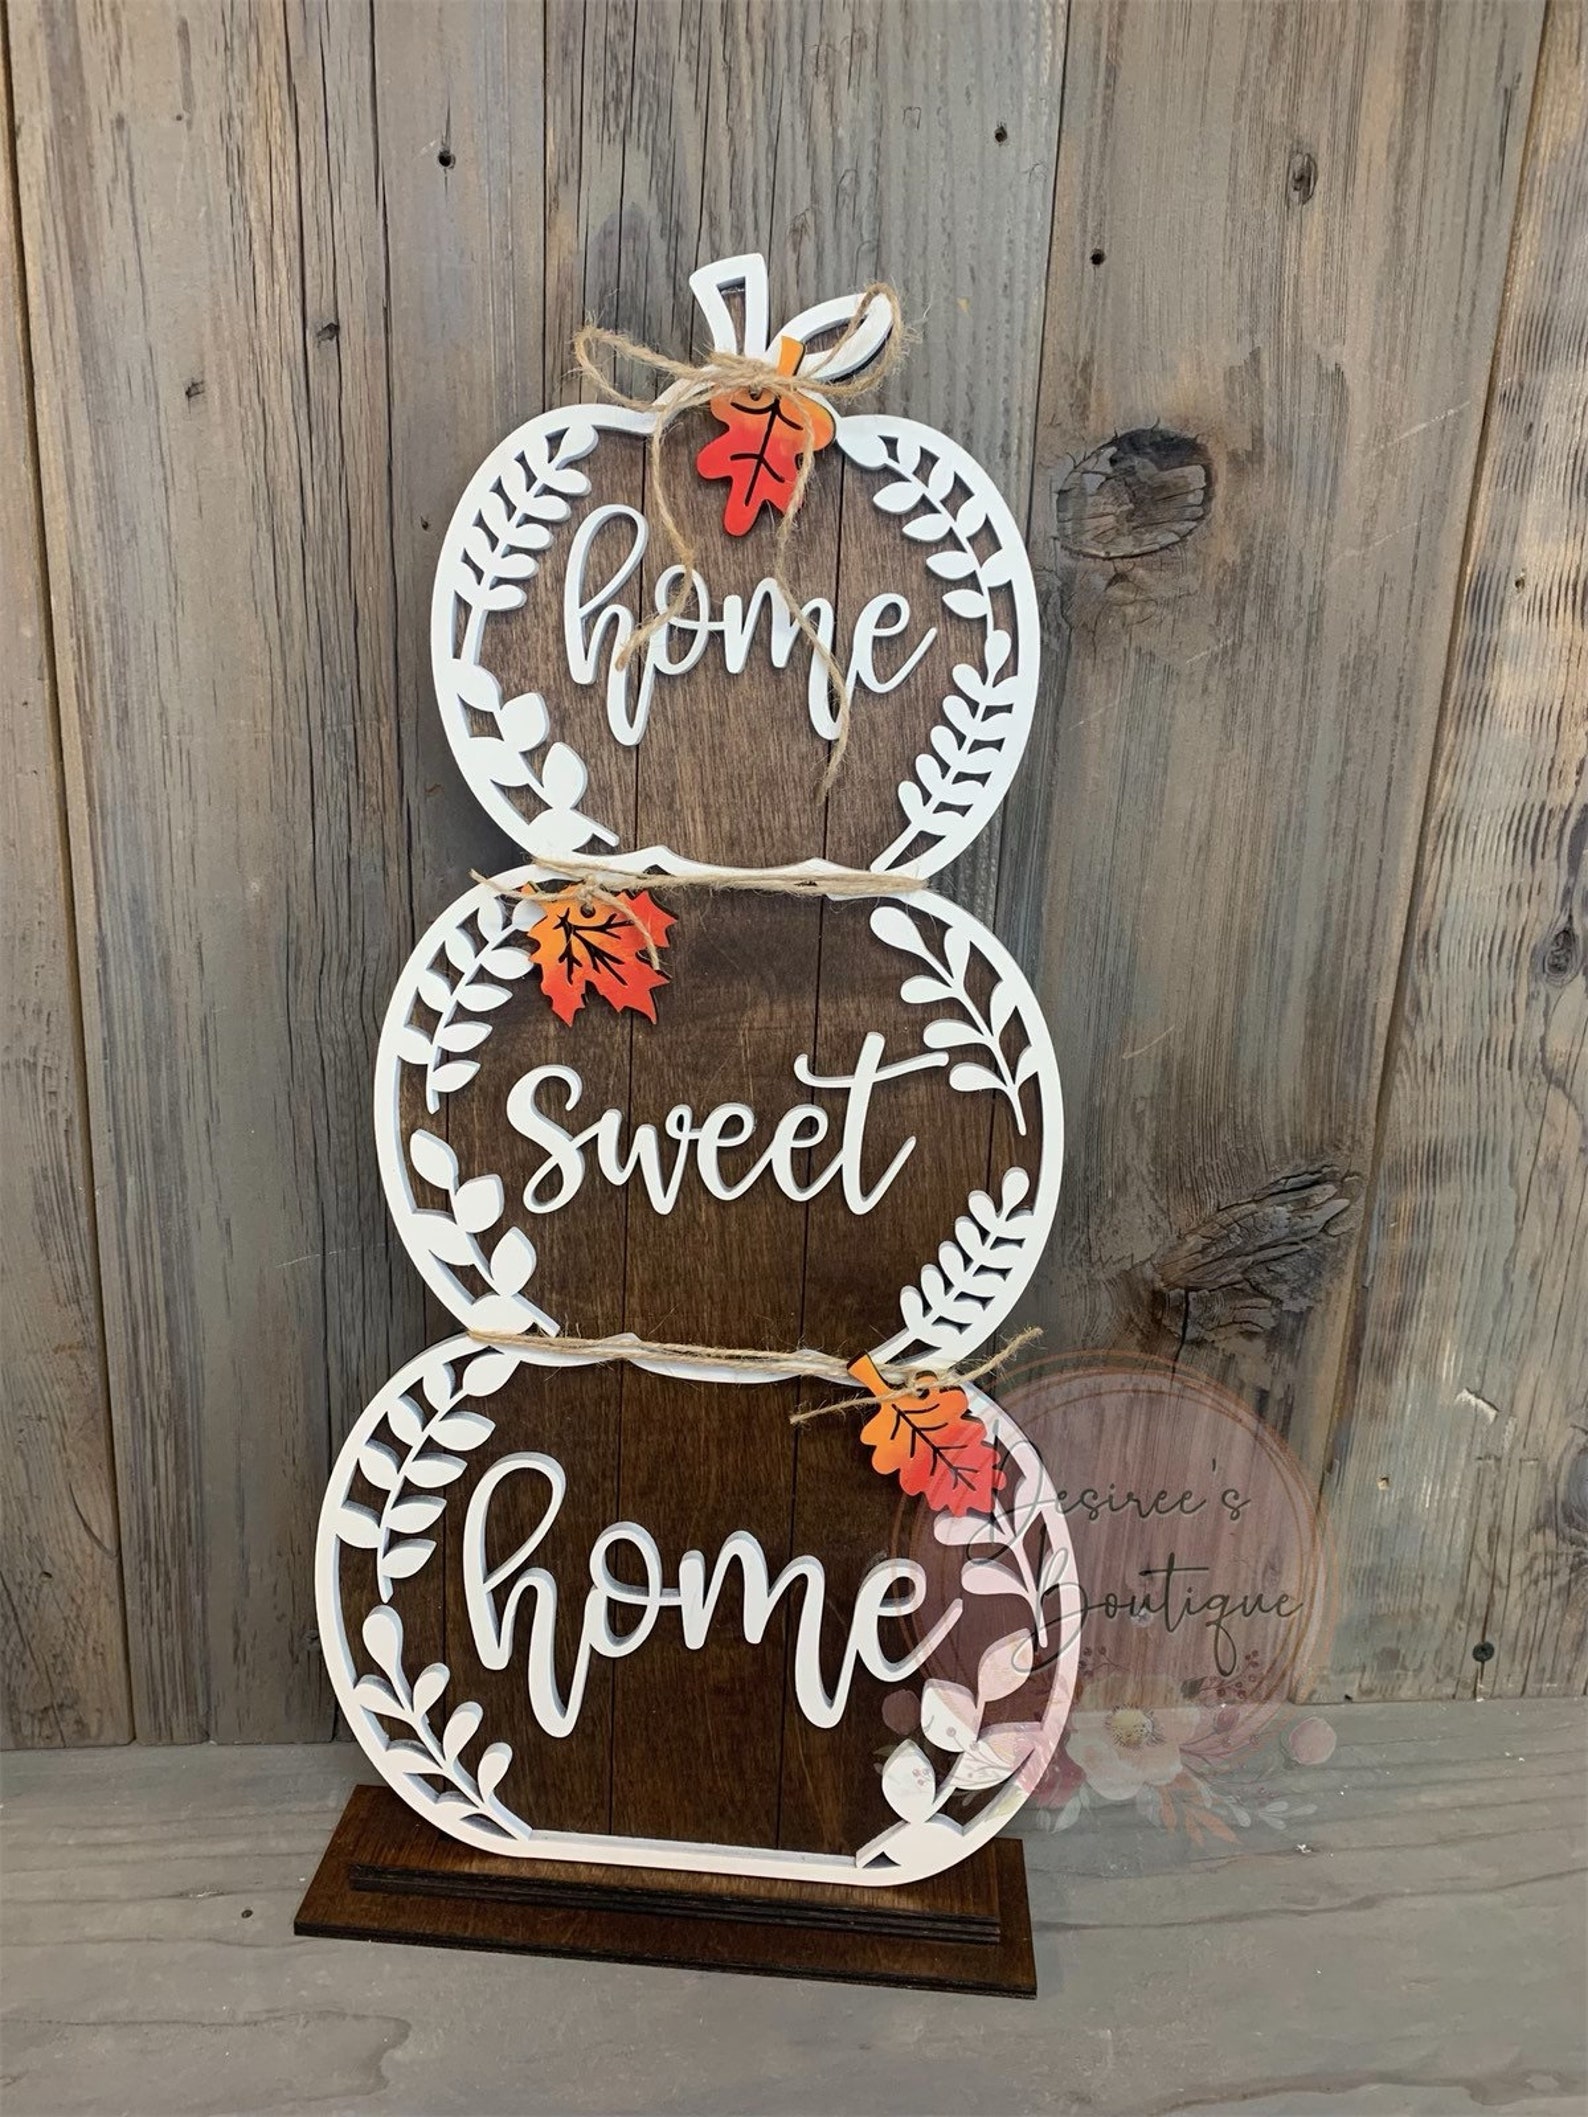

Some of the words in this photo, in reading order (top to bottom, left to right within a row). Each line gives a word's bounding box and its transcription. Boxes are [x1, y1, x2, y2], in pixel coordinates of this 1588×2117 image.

[564, 503, 938, 747] home
[506, 1031, 950, 1215] sweet
[463, 1451, 963, 1738] home
